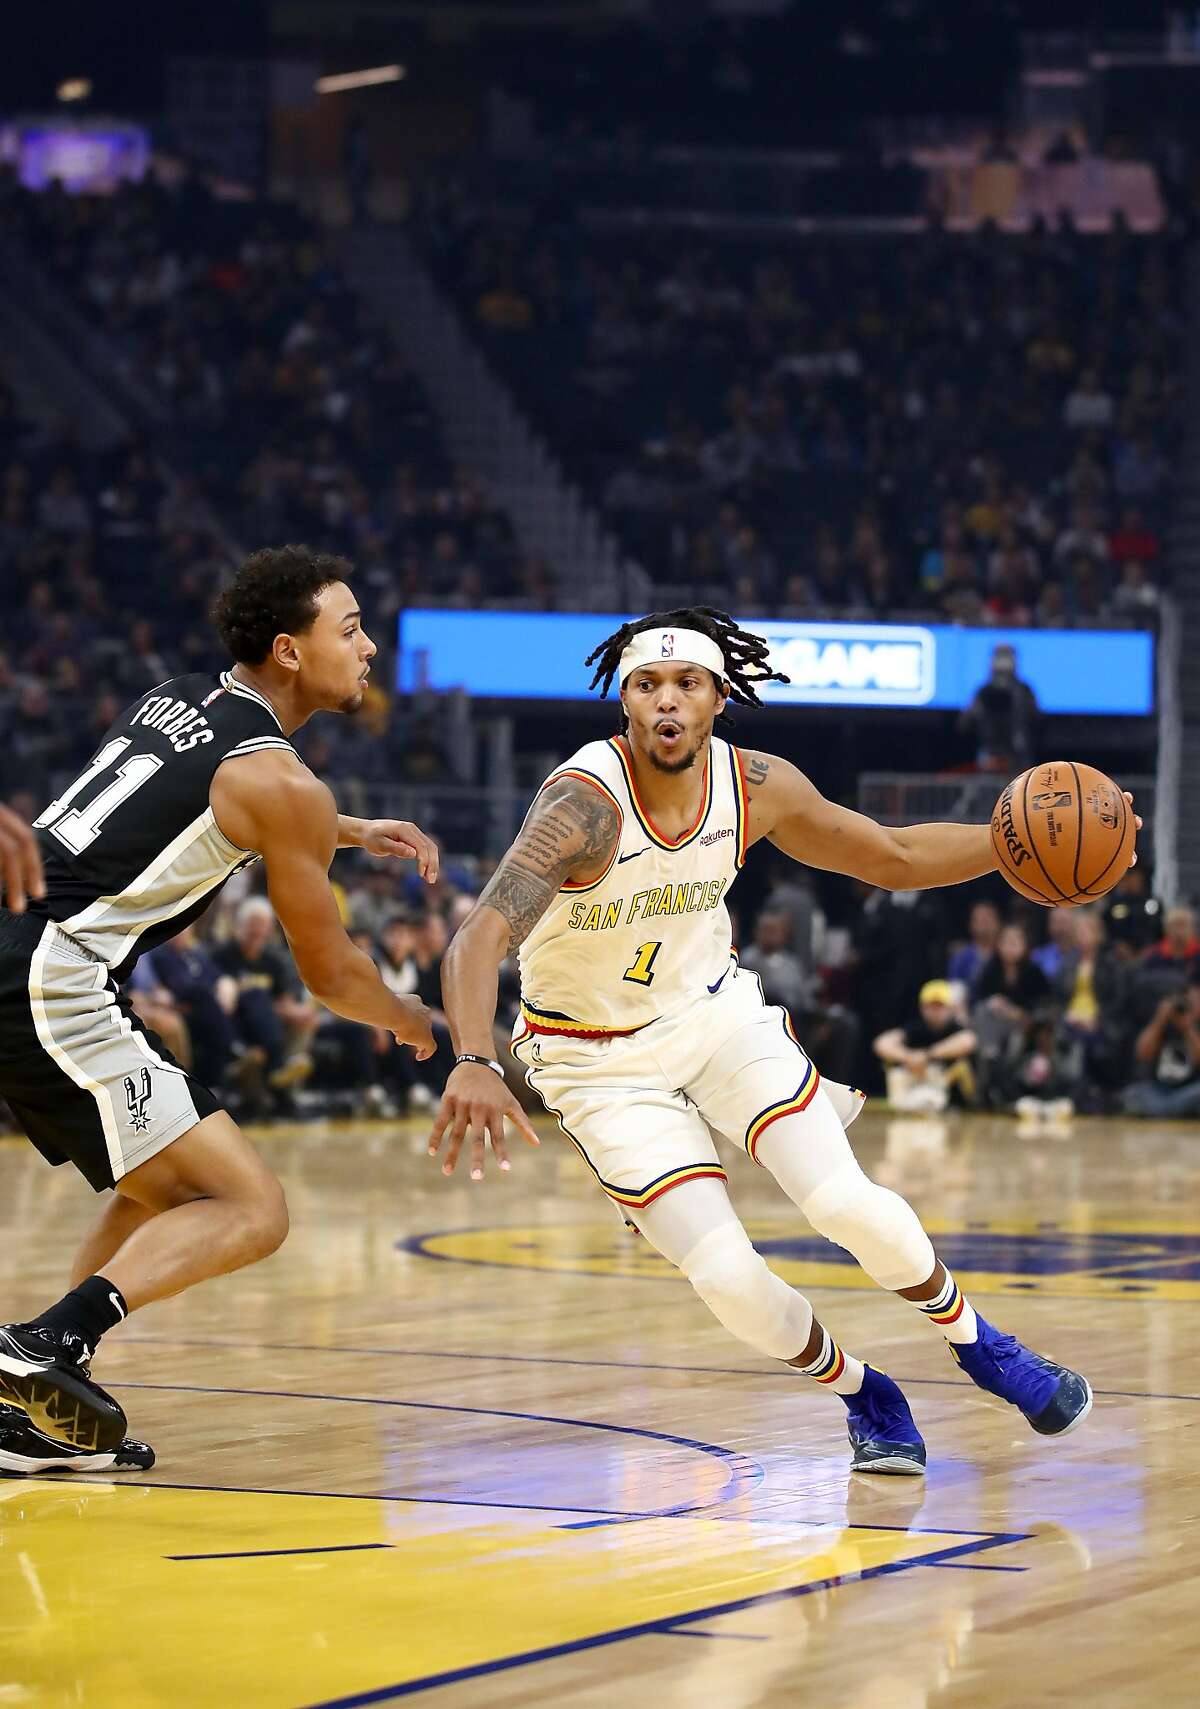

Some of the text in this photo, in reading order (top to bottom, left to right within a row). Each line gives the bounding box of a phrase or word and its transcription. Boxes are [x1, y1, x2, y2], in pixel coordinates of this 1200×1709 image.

[767, 639, 921, 690] GAME
[129, 696, 214, 753] FORBES
[31, 735, 165, 856] 11
[699, 828, 734, 846] Rakuten
[568, 899, 623, 930] SAN
[622, 941, 662, 987] 1
